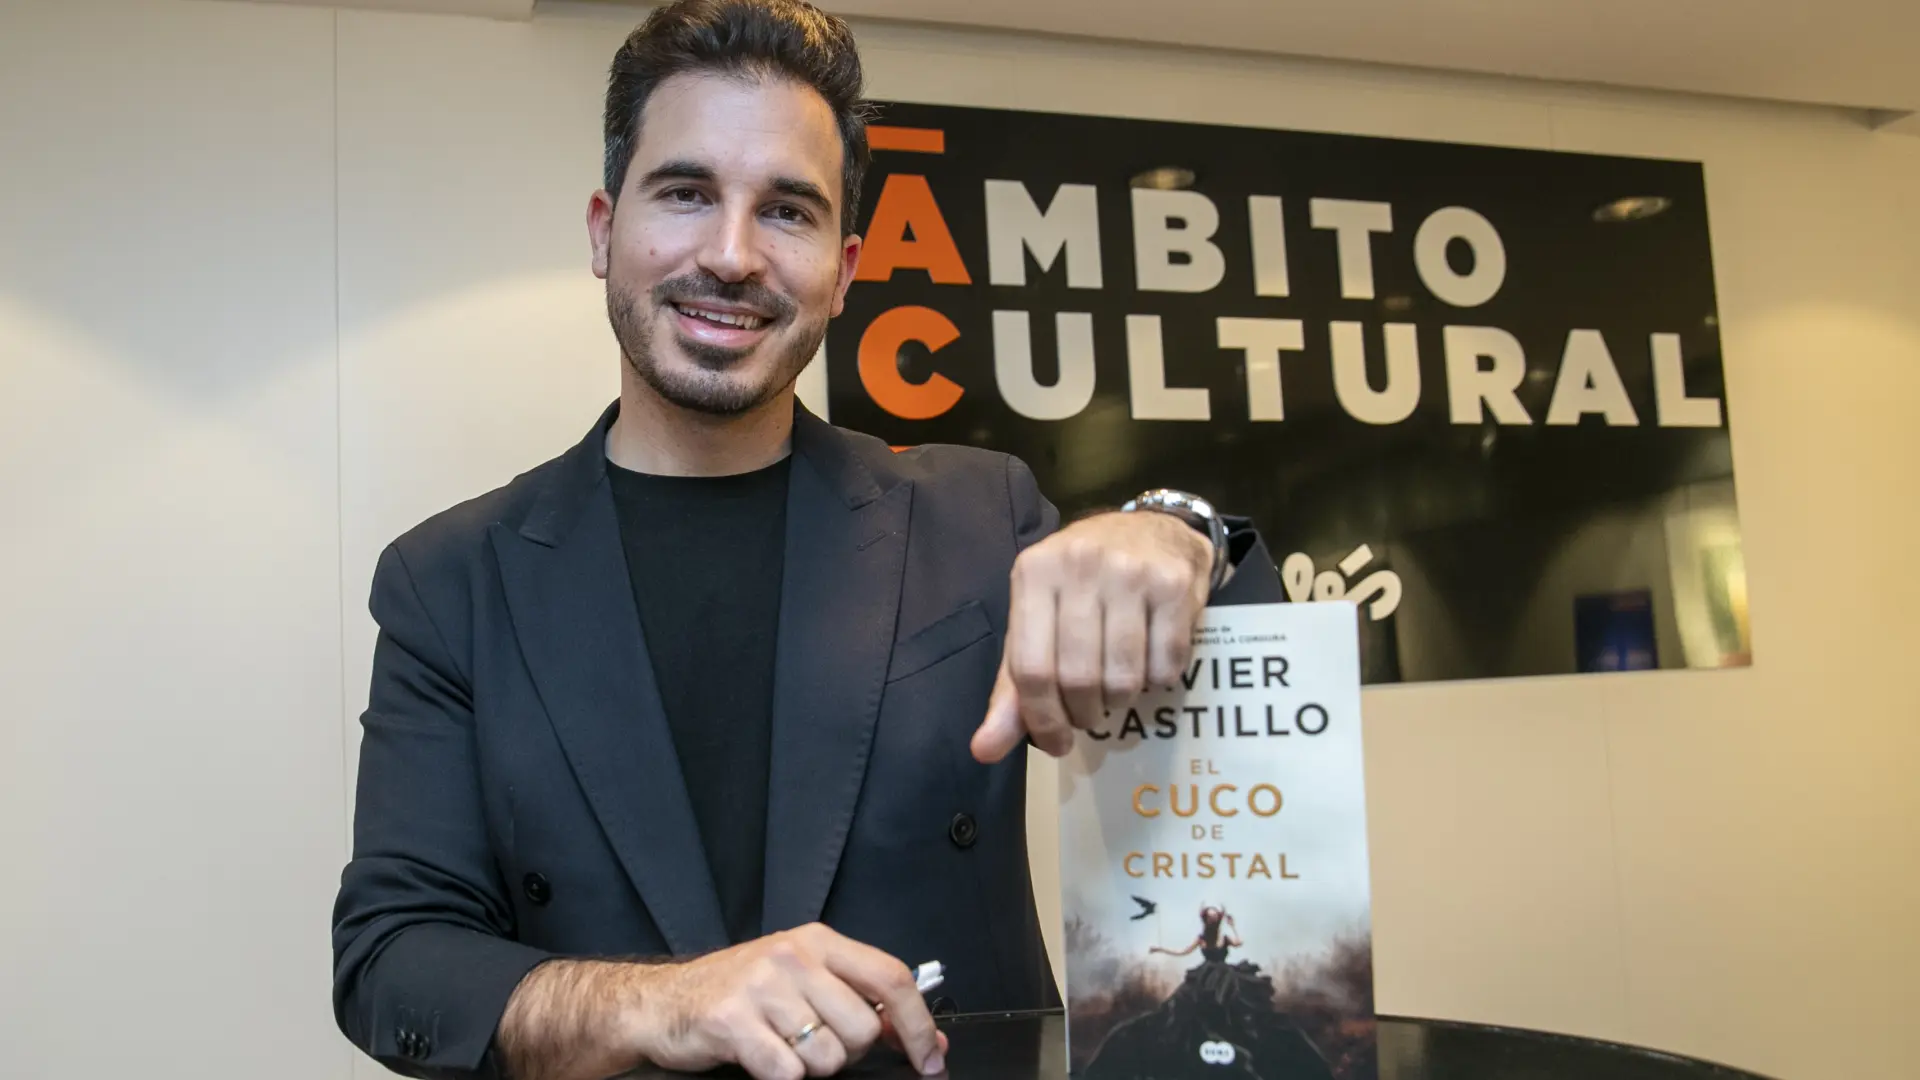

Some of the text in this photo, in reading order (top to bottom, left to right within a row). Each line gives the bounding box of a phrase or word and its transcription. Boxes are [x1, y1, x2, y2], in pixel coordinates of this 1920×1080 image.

[857, 305, 1722, 428] CULTURAL
[1142, 655, 1290, 692] VIER
[1190, 759, 1220, 775] EL
[1131, 783, 1283, 818] CUCO
[1191, 824, 1224, 840] DE
[1123, 852, 1300, 880] CRISTAL
